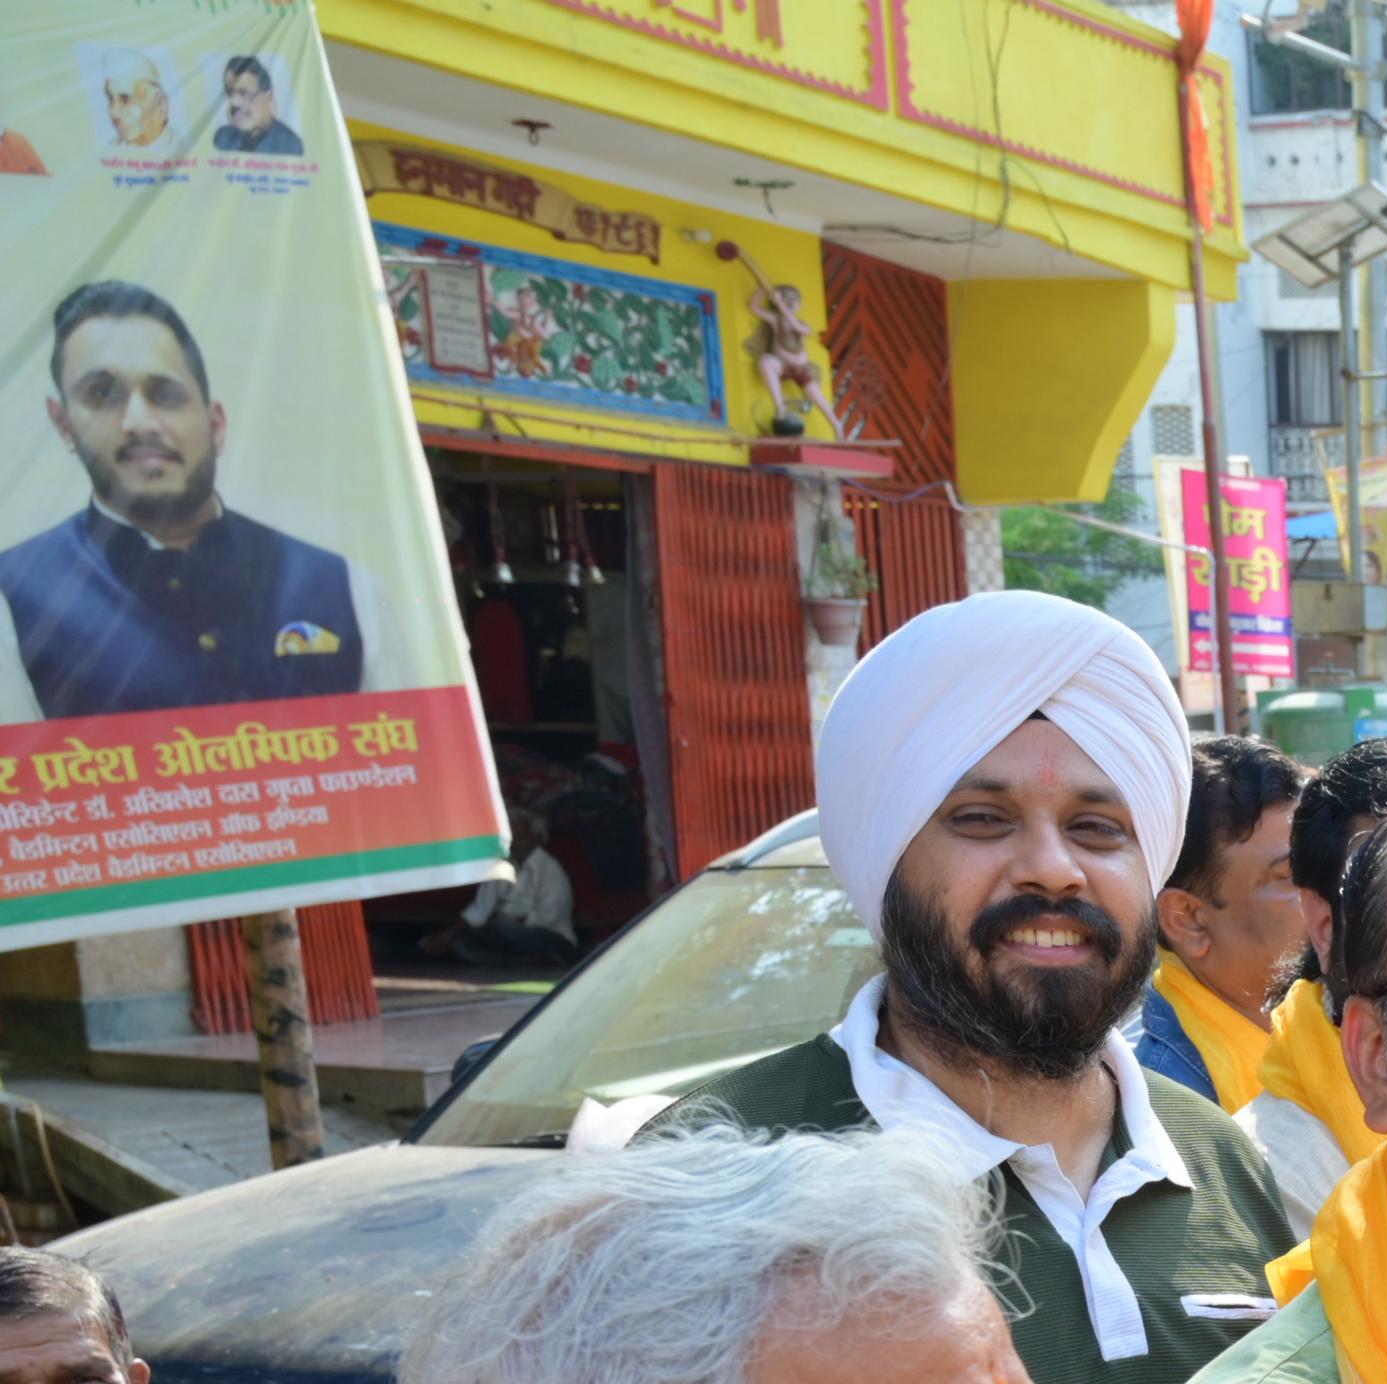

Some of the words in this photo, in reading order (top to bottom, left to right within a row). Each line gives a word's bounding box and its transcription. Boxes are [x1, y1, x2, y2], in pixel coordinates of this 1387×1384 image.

[33, 738, 137, 793] प्रदेश
[156, 723, 338, 778] ओलम्पिक
[350, 713, 418, 755] संघ
[122, 783, 213, 816] अखिलेश
[218, 781, 260, 804] दास
[53, 859, 101, 887] प्रदेश
